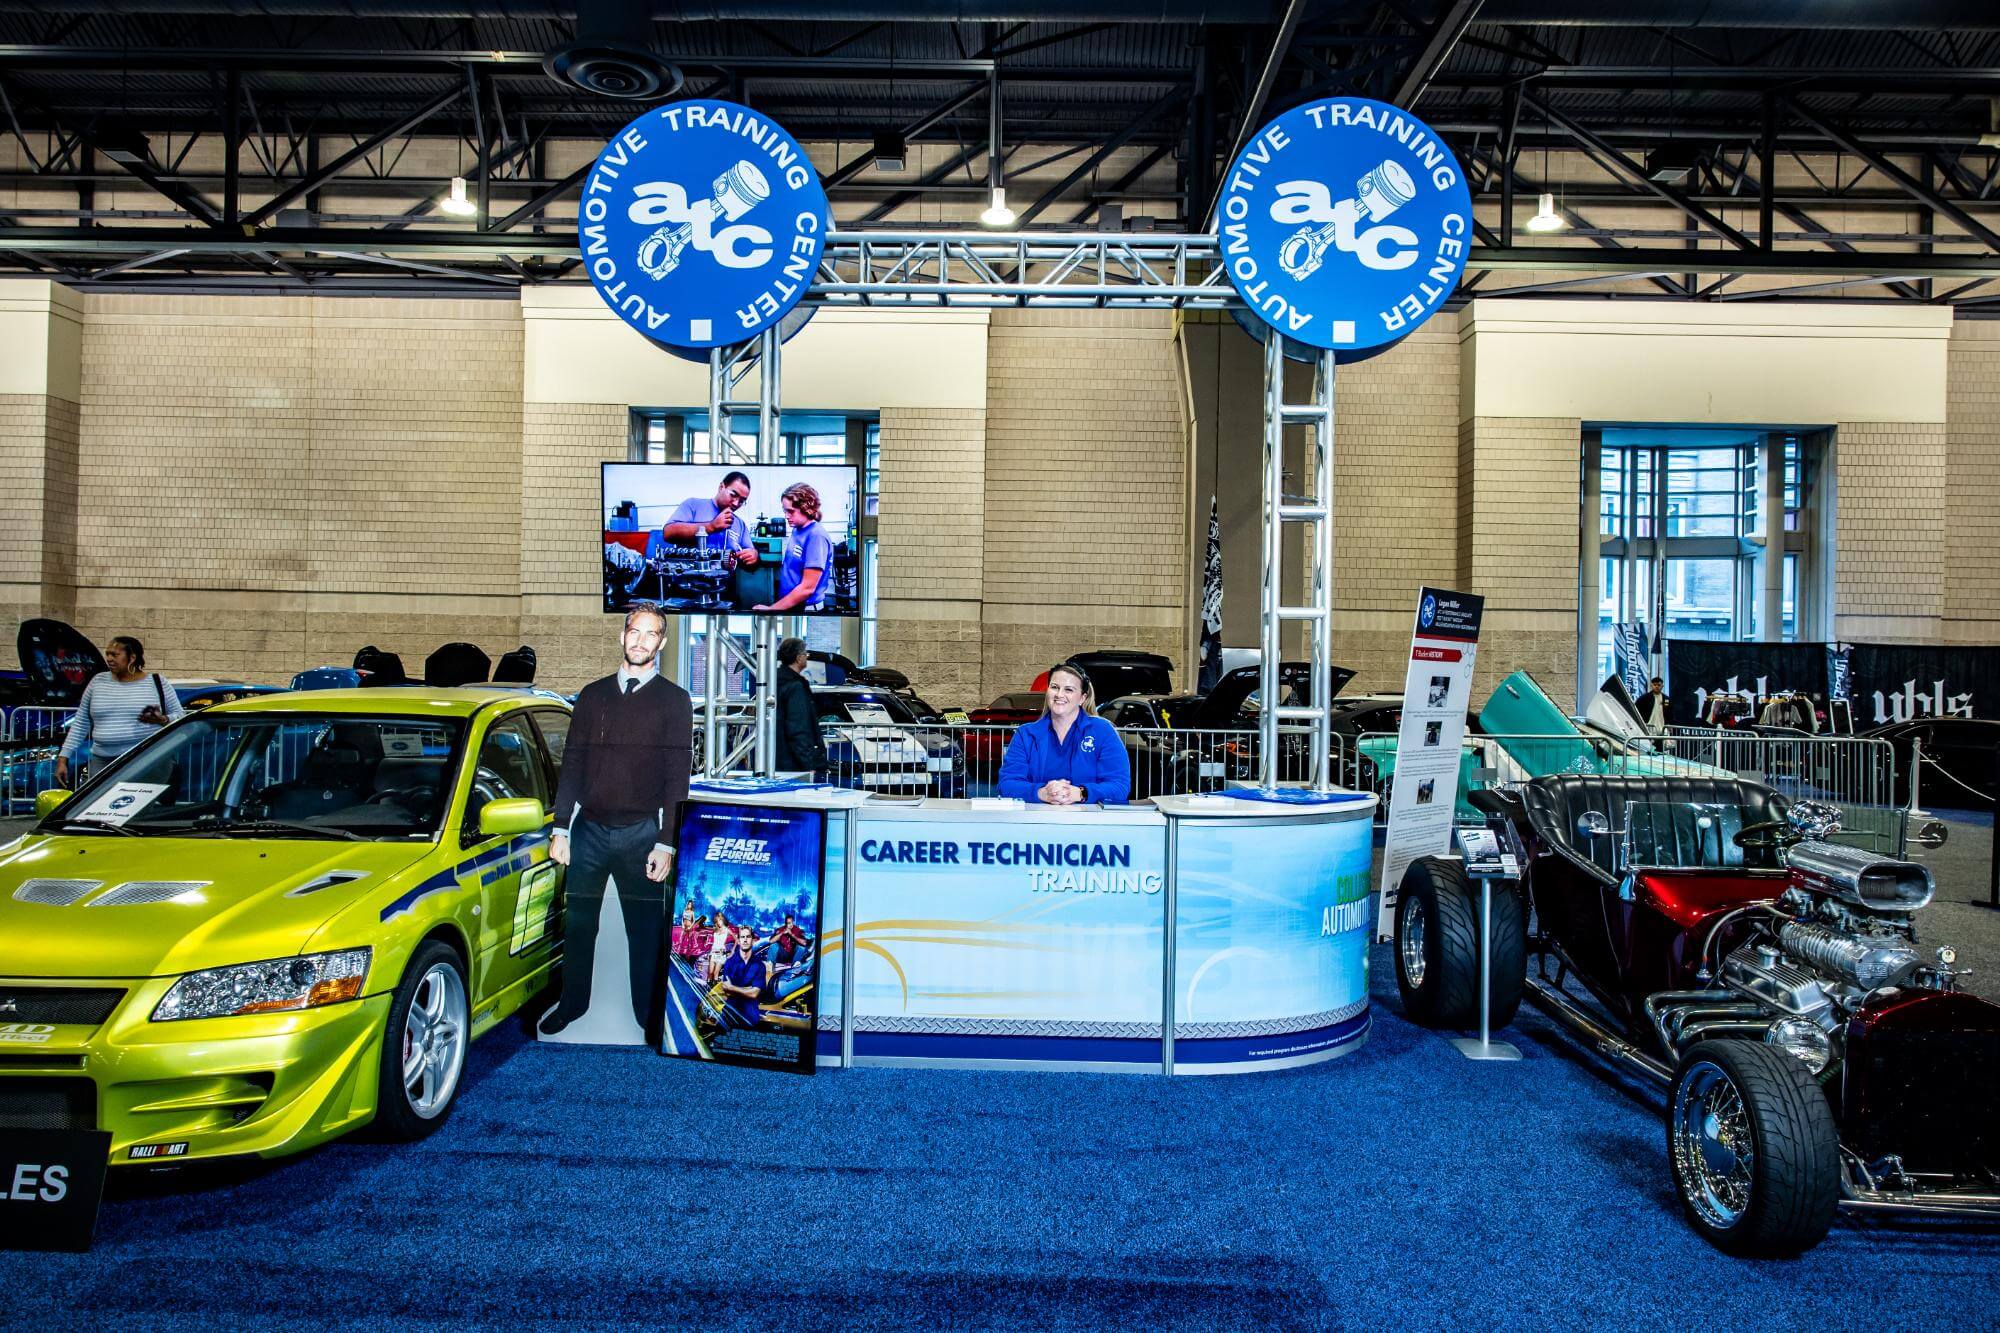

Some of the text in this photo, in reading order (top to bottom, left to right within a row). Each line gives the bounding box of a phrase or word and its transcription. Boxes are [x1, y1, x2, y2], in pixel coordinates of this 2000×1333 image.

[584, 106, 818, 329] AUTOMOTIVE TRAINING CENTER
[628, 182, 773, 268] atc
[1225, 104, 1465, 331] AUTOMOTIVE TRAINING CENTER
[1270, 180, 1419, 270] atc
[720, 850, 771, 862] FURIOUS
[723, 838, 768, 852] FAST
[861, 839, 1130, 867] CAREER TECHNICIAN
[1028, 869, 1163, 894] TRAINING
